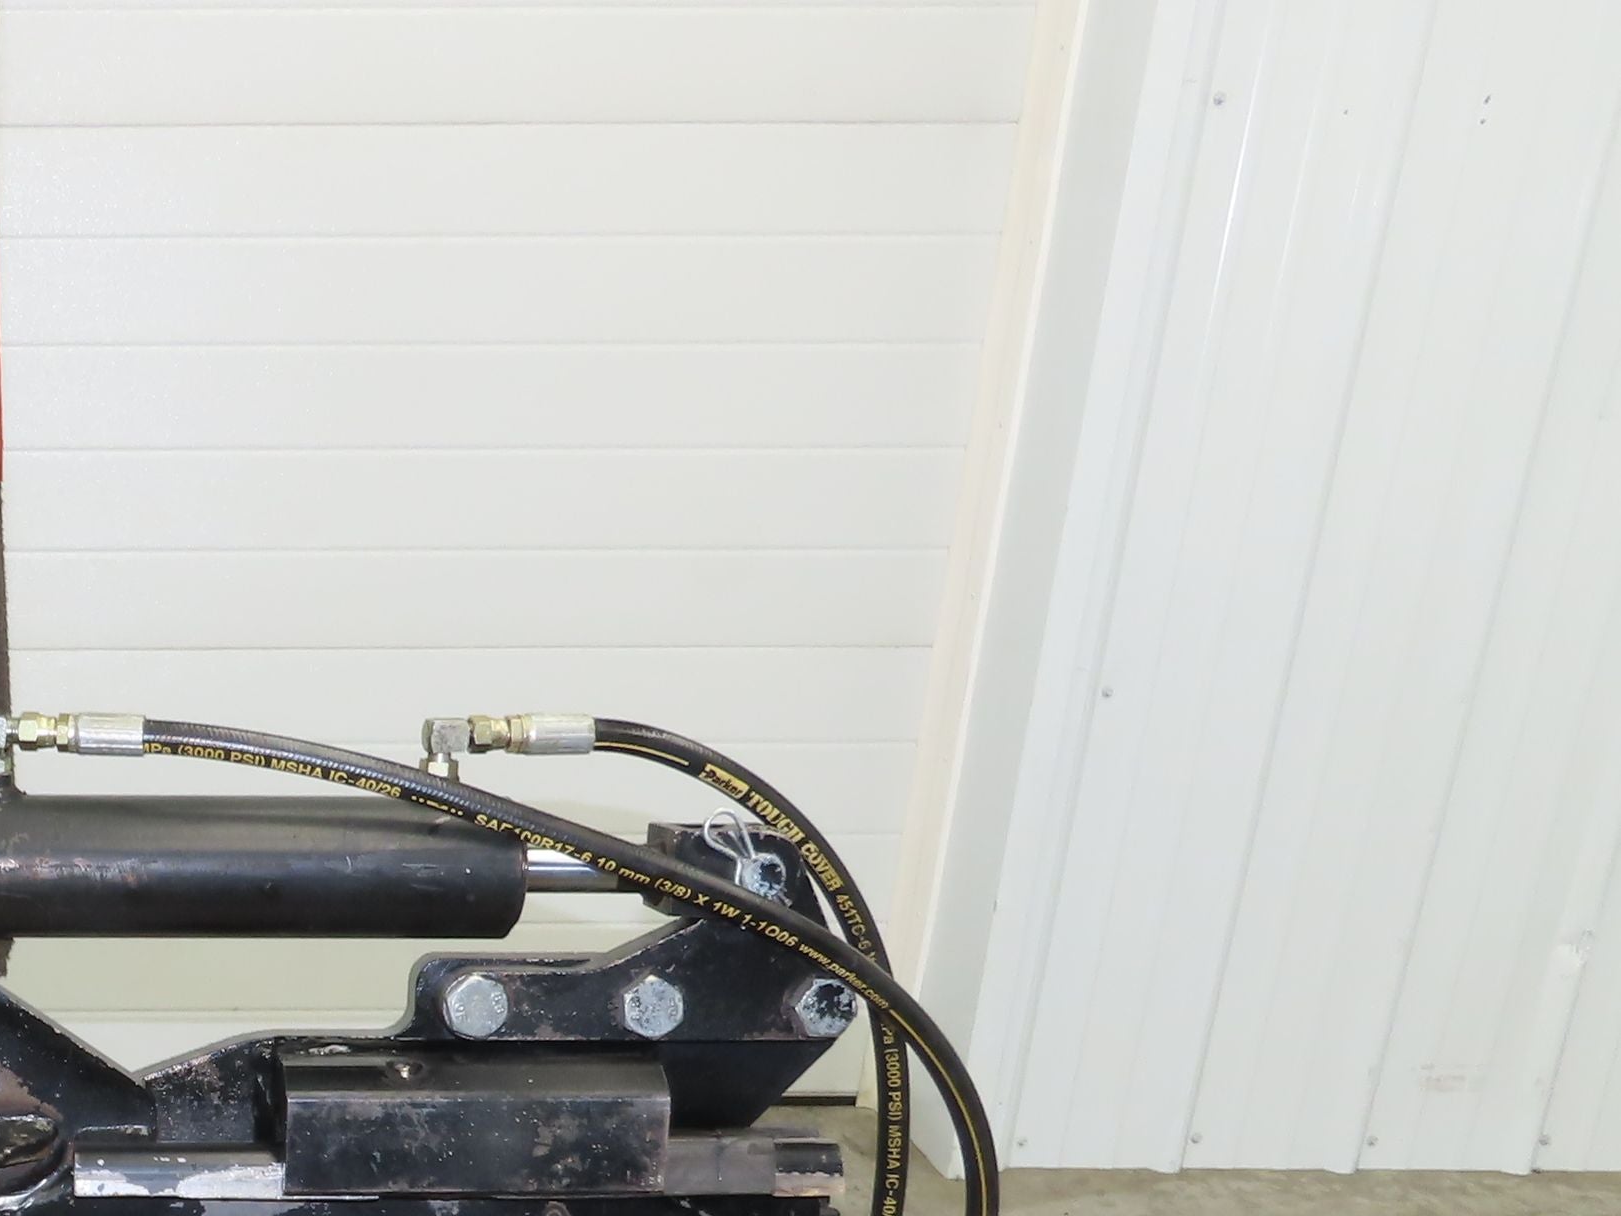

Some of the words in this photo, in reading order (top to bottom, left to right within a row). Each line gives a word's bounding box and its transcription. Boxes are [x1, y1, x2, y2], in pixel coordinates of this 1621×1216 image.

[178, 745, 225, 761] (3000
[271, 759, 323, 779] MSHA
[328, 770, 403, 799] IC-40/26
[700, 767, 747, 798] Parker
[748, 791, 806, 844] TOUGH
[800, 840, 845, 892] COVER
[835, 893, 873, 950] 451TC-6
[596, 857, 617, 873] 10
[618, 867, 652, 886] mm
[654, 878, 692, 900] (3/8)
[693, 893, 708, 906] X
[713, 901, 742, 919] 1W
[798, 942, 890, 1010] www.parker.com
[883, 1048, 903, 1088] (3000
[887, 1091, 902, 1122] PSI)
[886, 1124, 902, 1171] MSHA
